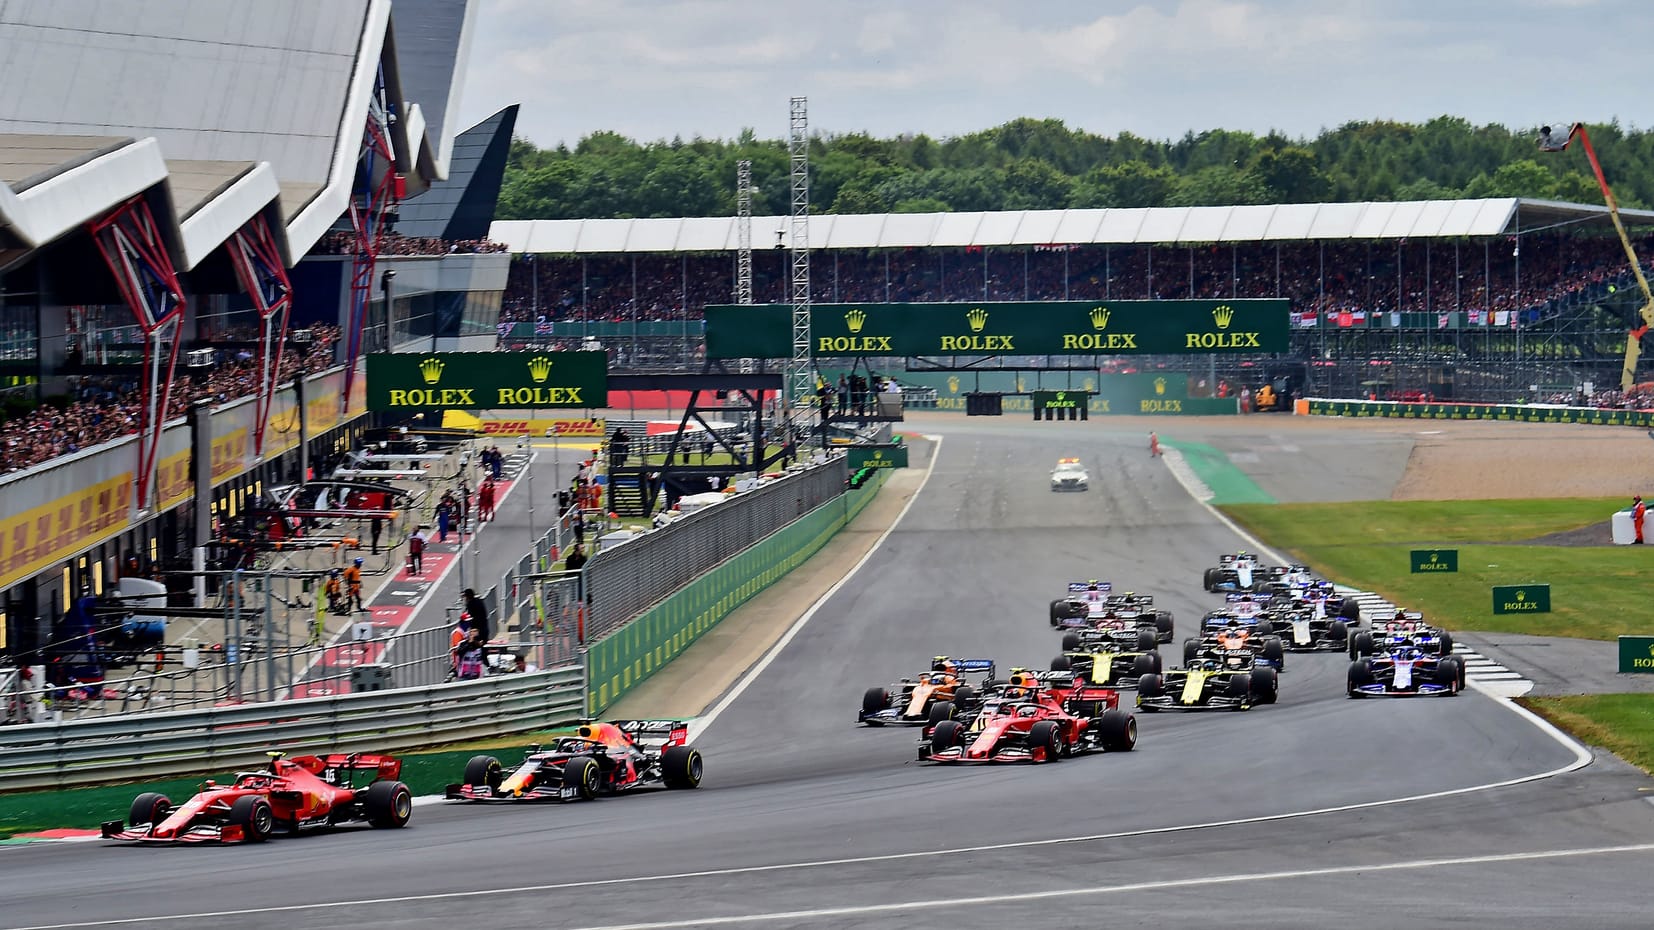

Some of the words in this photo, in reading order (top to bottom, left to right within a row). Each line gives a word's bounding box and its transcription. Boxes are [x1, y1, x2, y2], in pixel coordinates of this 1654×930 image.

[819, 336, 892, 352] ROLEX
[941, 335, 1014, 351] ROLEX
[1063, 334, 1137, 350] ROLEX
[1186, 332, 1260, 349] ROLEX
[390, 388, 475, 406] ROLEX
[498, 387, 583, 405] ROLEX
[1046, 400, 1076, 408] ROLEX
[1140, 399, 1182, 412] ROLEX
[483, 422, 530, 434] DHL
[553, 422, 599, 433] DHL
[863, 460, 893, 468] ROLEX
[1503, 601, 1538, 611] ROLEX
